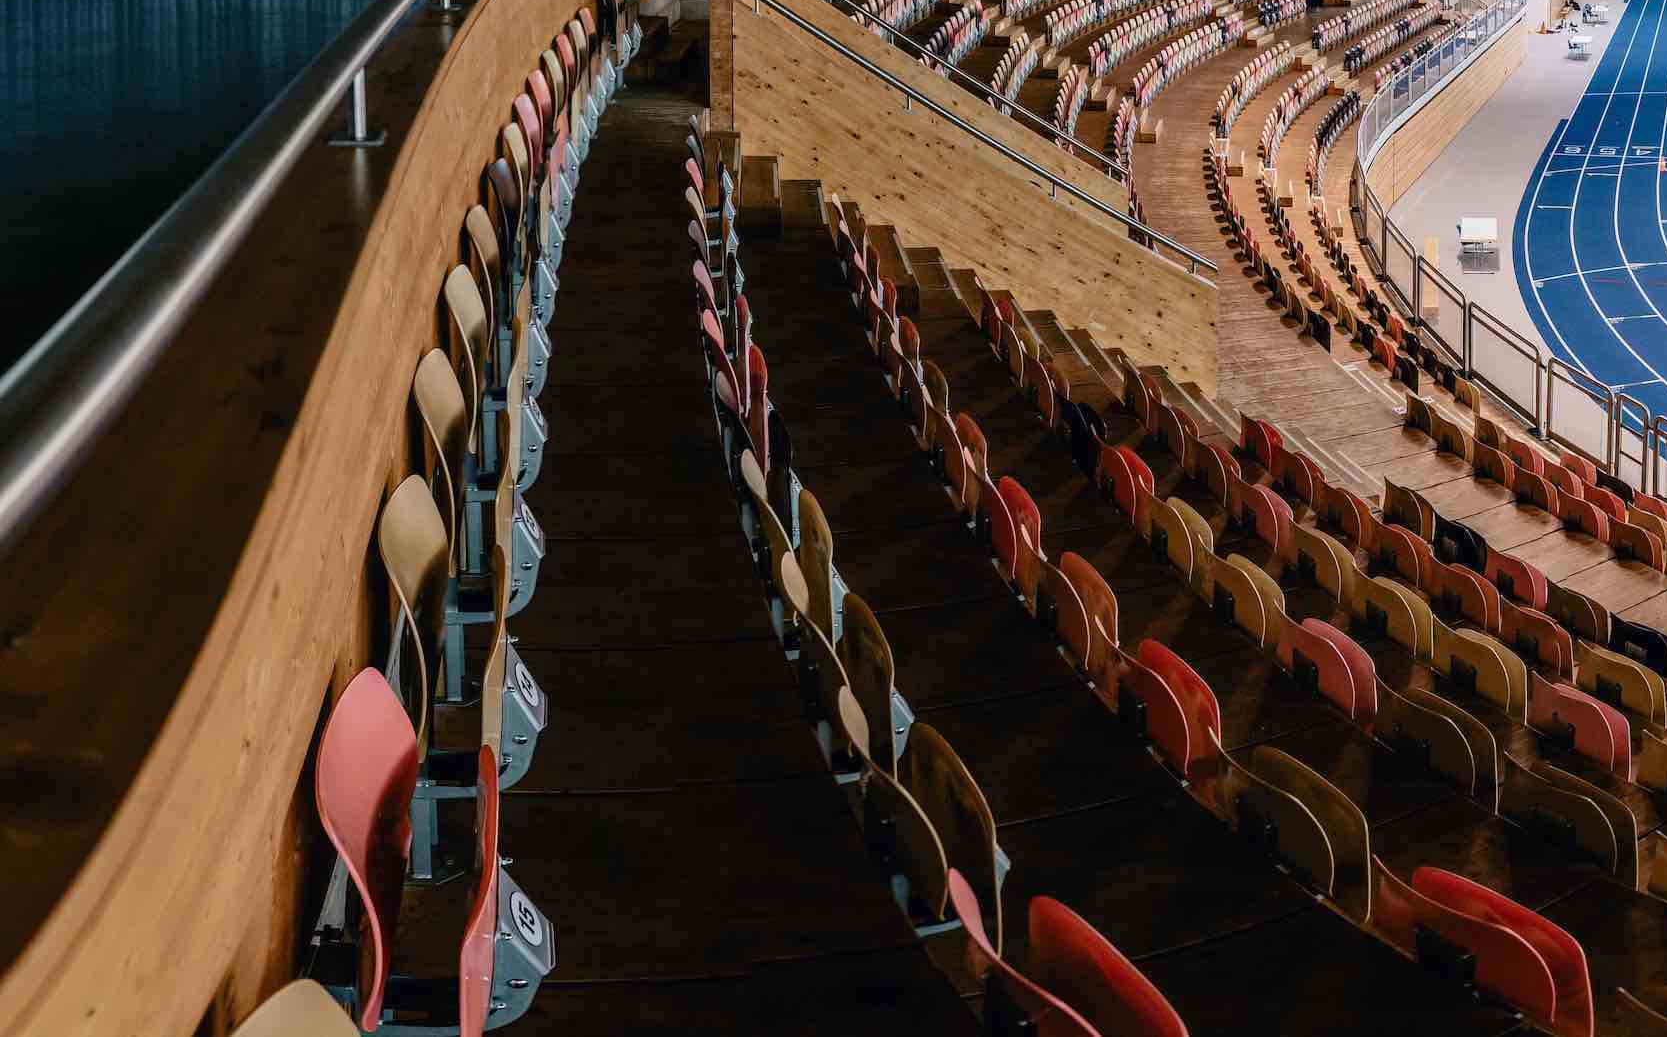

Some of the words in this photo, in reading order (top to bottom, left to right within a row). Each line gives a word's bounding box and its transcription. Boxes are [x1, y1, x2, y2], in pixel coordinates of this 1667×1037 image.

[1599, 147, 1617, 156] 5
[1636, 148, 1652, 156] 4
[521, 670, 534, 698] 14
[519, 900, 535, 935] 15
